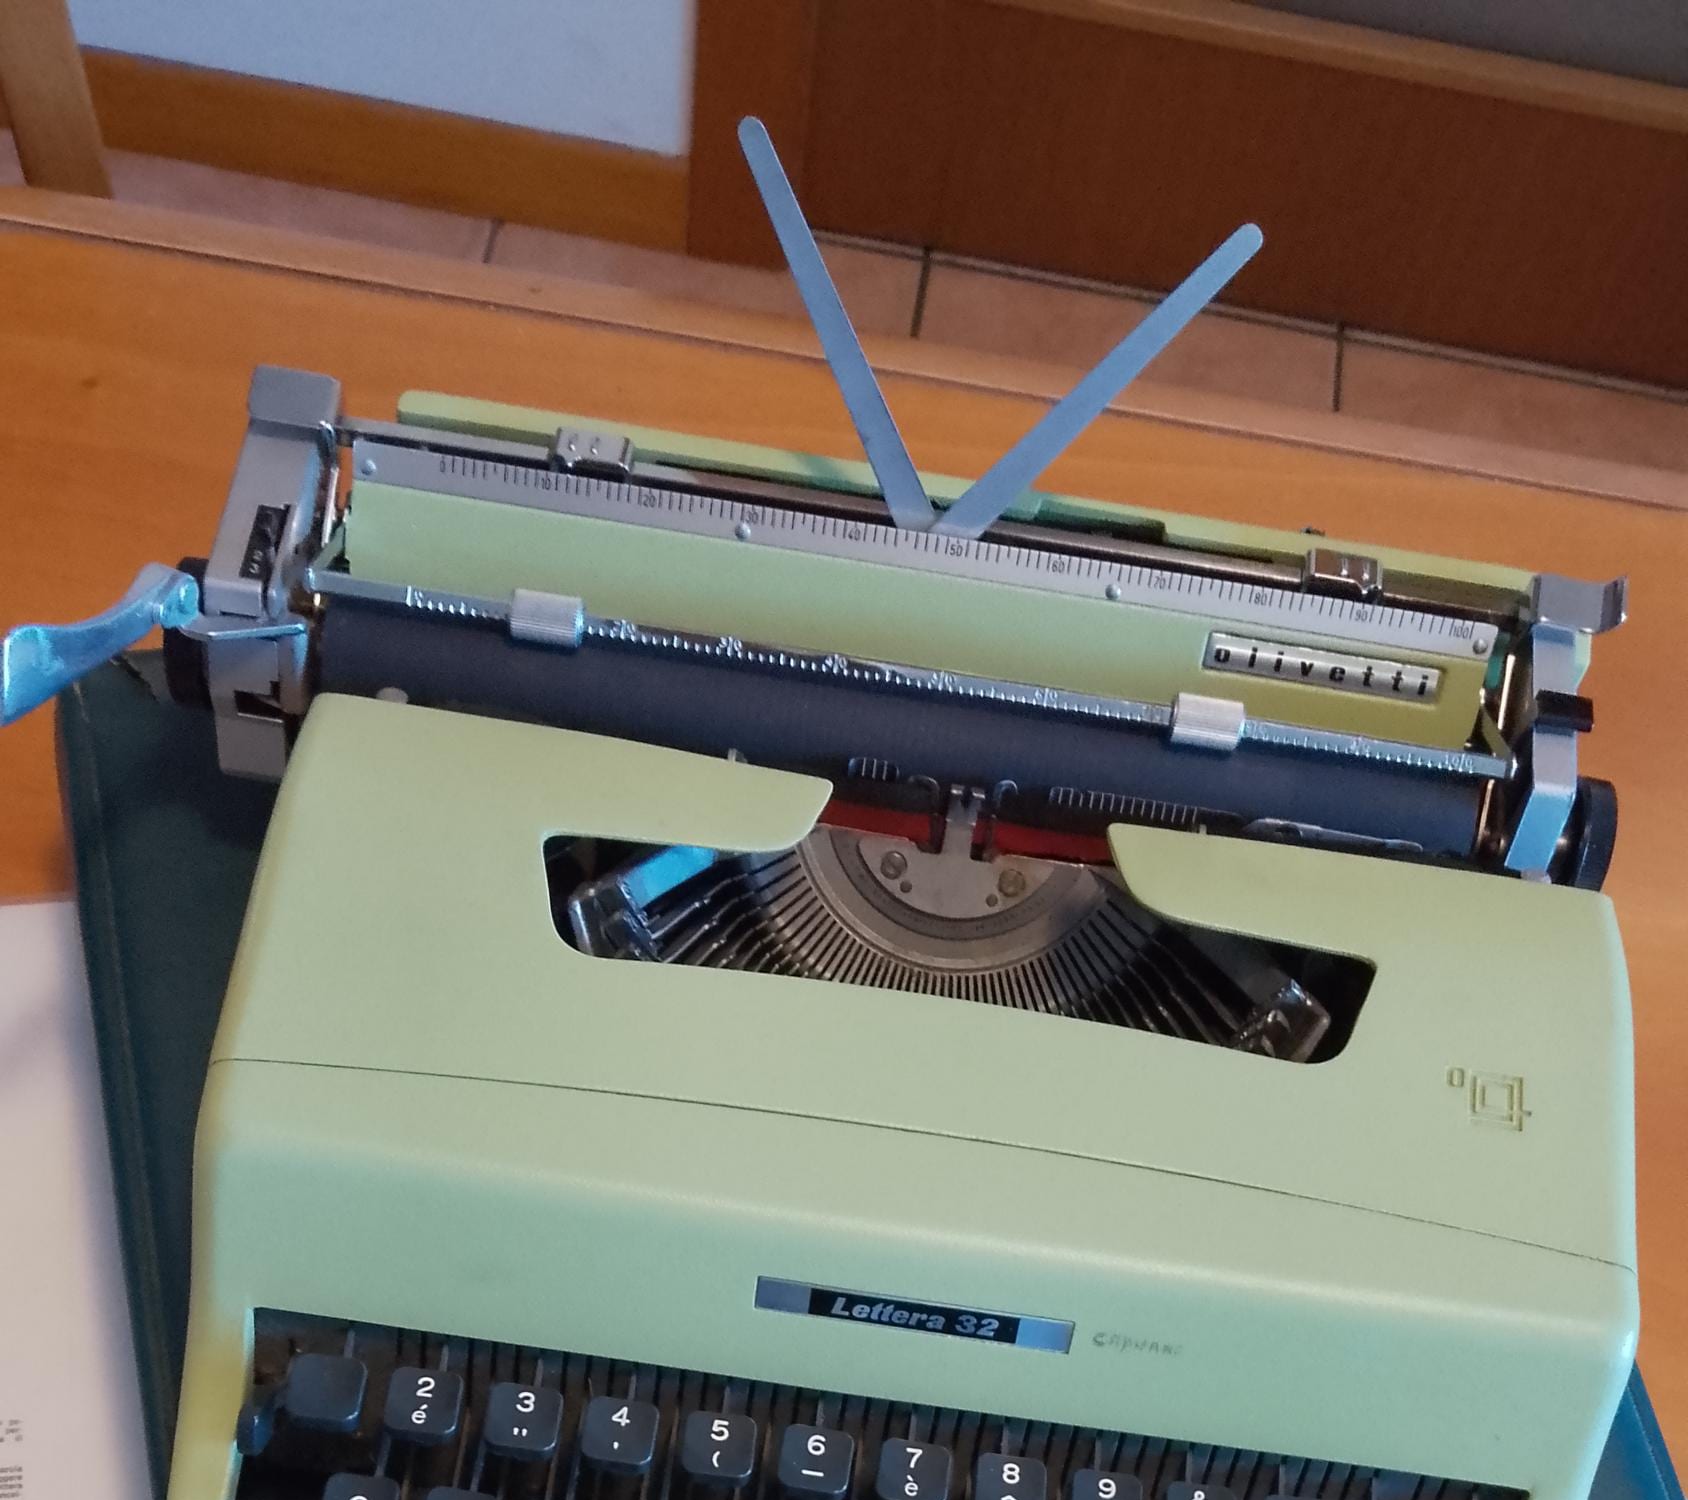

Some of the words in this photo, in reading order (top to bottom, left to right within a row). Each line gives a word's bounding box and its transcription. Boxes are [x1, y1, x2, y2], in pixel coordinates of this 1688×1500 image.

[848, 528, 861, 541] 40
[949, 545, 964, 557] 50
[1052, 560, 1065, 574] 60
[1154, 576, 1166, 590] 70
[1254, 592, 1268, 606] 80
[1354, 609, 1368, 622] 90
[1453, 626, 1470, 639] 100
[1214, 646, 1430, 696] olivetti
[830, 1296, 946, 1331] Lettera
[954, 1314, 1001, 1338] 32
[415, 1376, 436, 1398] 2
[515, 1391, 536, 1413] 3
[411, 1403, 429, 1425] é
[611, 1406, 631, 1427] 4
[710, 1419, 730, 1442] 5
[807, 1434, 827, 1456] 6
[905, 1447, 923, 1469] 7
[1002, 1462, 1021, 1485] 8
[904, 1474, 919, 1497] è
[1098, 1478, 1117, 1500] 9
